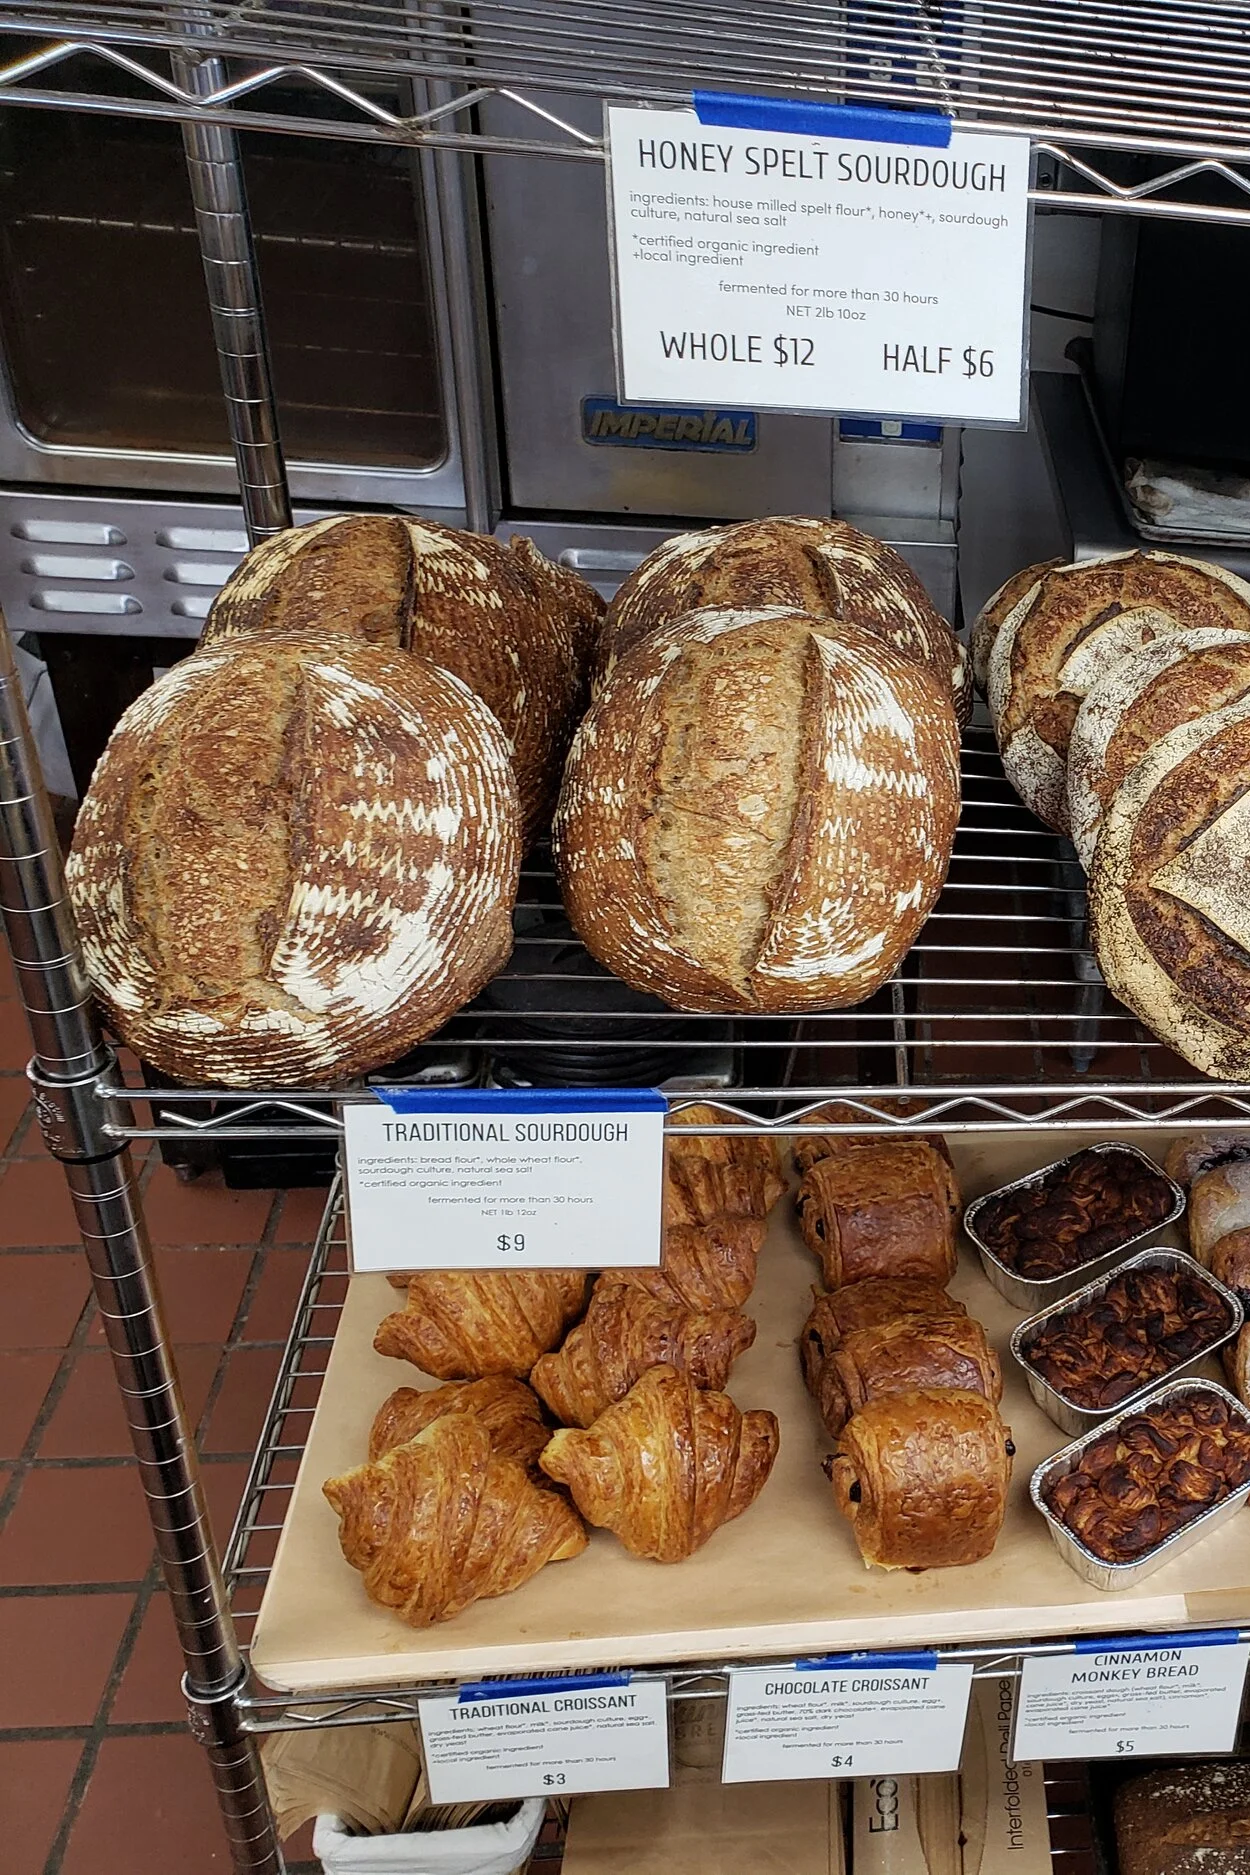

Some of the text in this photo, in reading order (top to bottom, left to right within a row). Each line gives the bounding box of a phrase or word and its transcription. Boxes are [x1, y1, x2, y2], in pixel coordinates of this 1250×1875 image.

[638, 138, 1005, 192] HONEY SPELT SOURDOUGH
[629, 191, 709, 212] ingredients:
[712, 196, 753, 213] house
[756, 199, 797, 216] milled
[799, 202, 832, 217] spelt
[938, 211, 1008, 229] sourdough
[629, 206, 787, 227] culture, natural sea salt
[696, 238, 749, 254] organic
[751, 240, 819, 256] ingredient
[632, 247, 743, 266] +local ingredient
[717, 279, 939, 305] fermented for more than 30 hours
[785, 303, 867, 321] NET 2lb 10oz
[659, 329, 993, 379] WHOLE $12 HALF $6
[588, 409, 752, 446] IMPERIAL
[381, 1122, 628, 1142] TRADITIONAL SOURDOUGH
[357, 1155, 418, 1166] ingredients:
[419, 1155, 452, 1164] bread
[485, 1155, 517, 1164] whole
[518, 1155, 552, 1164] wheat
[357, 1165, 414, 1175] sourdough
[456, 1165, 493, 1174] natural
[494, 1166, 514, 1174] sea
[515, 1165, 533, 1174] salt
[408, 1178, 449, 1189] organic
[450, 1178, 502, 1189] ingredient
[427, 1194, 594, 1204] fermented for more than 30 hours
[480, 1207, 537, 1216] NET 1lb 12oz
[496, 1233, 525, 1251] $9
[1094, 1649, 1182, 1666] CINNAMON
[1071, 1663, 1199, 1683] MONKEY BREAD
[764, 1676, 930, 1695] CHOCOLATE CROISSANT
[448, 1693, 637, 1720] TRADITIONAL CROISSANT
[997, 1680, 1013, 1720] Pape
[1115, 1739, 1135, 1754] $5
[830, 1754, 853, 1768] $4
[542, 1771, 566, 1786] $3
